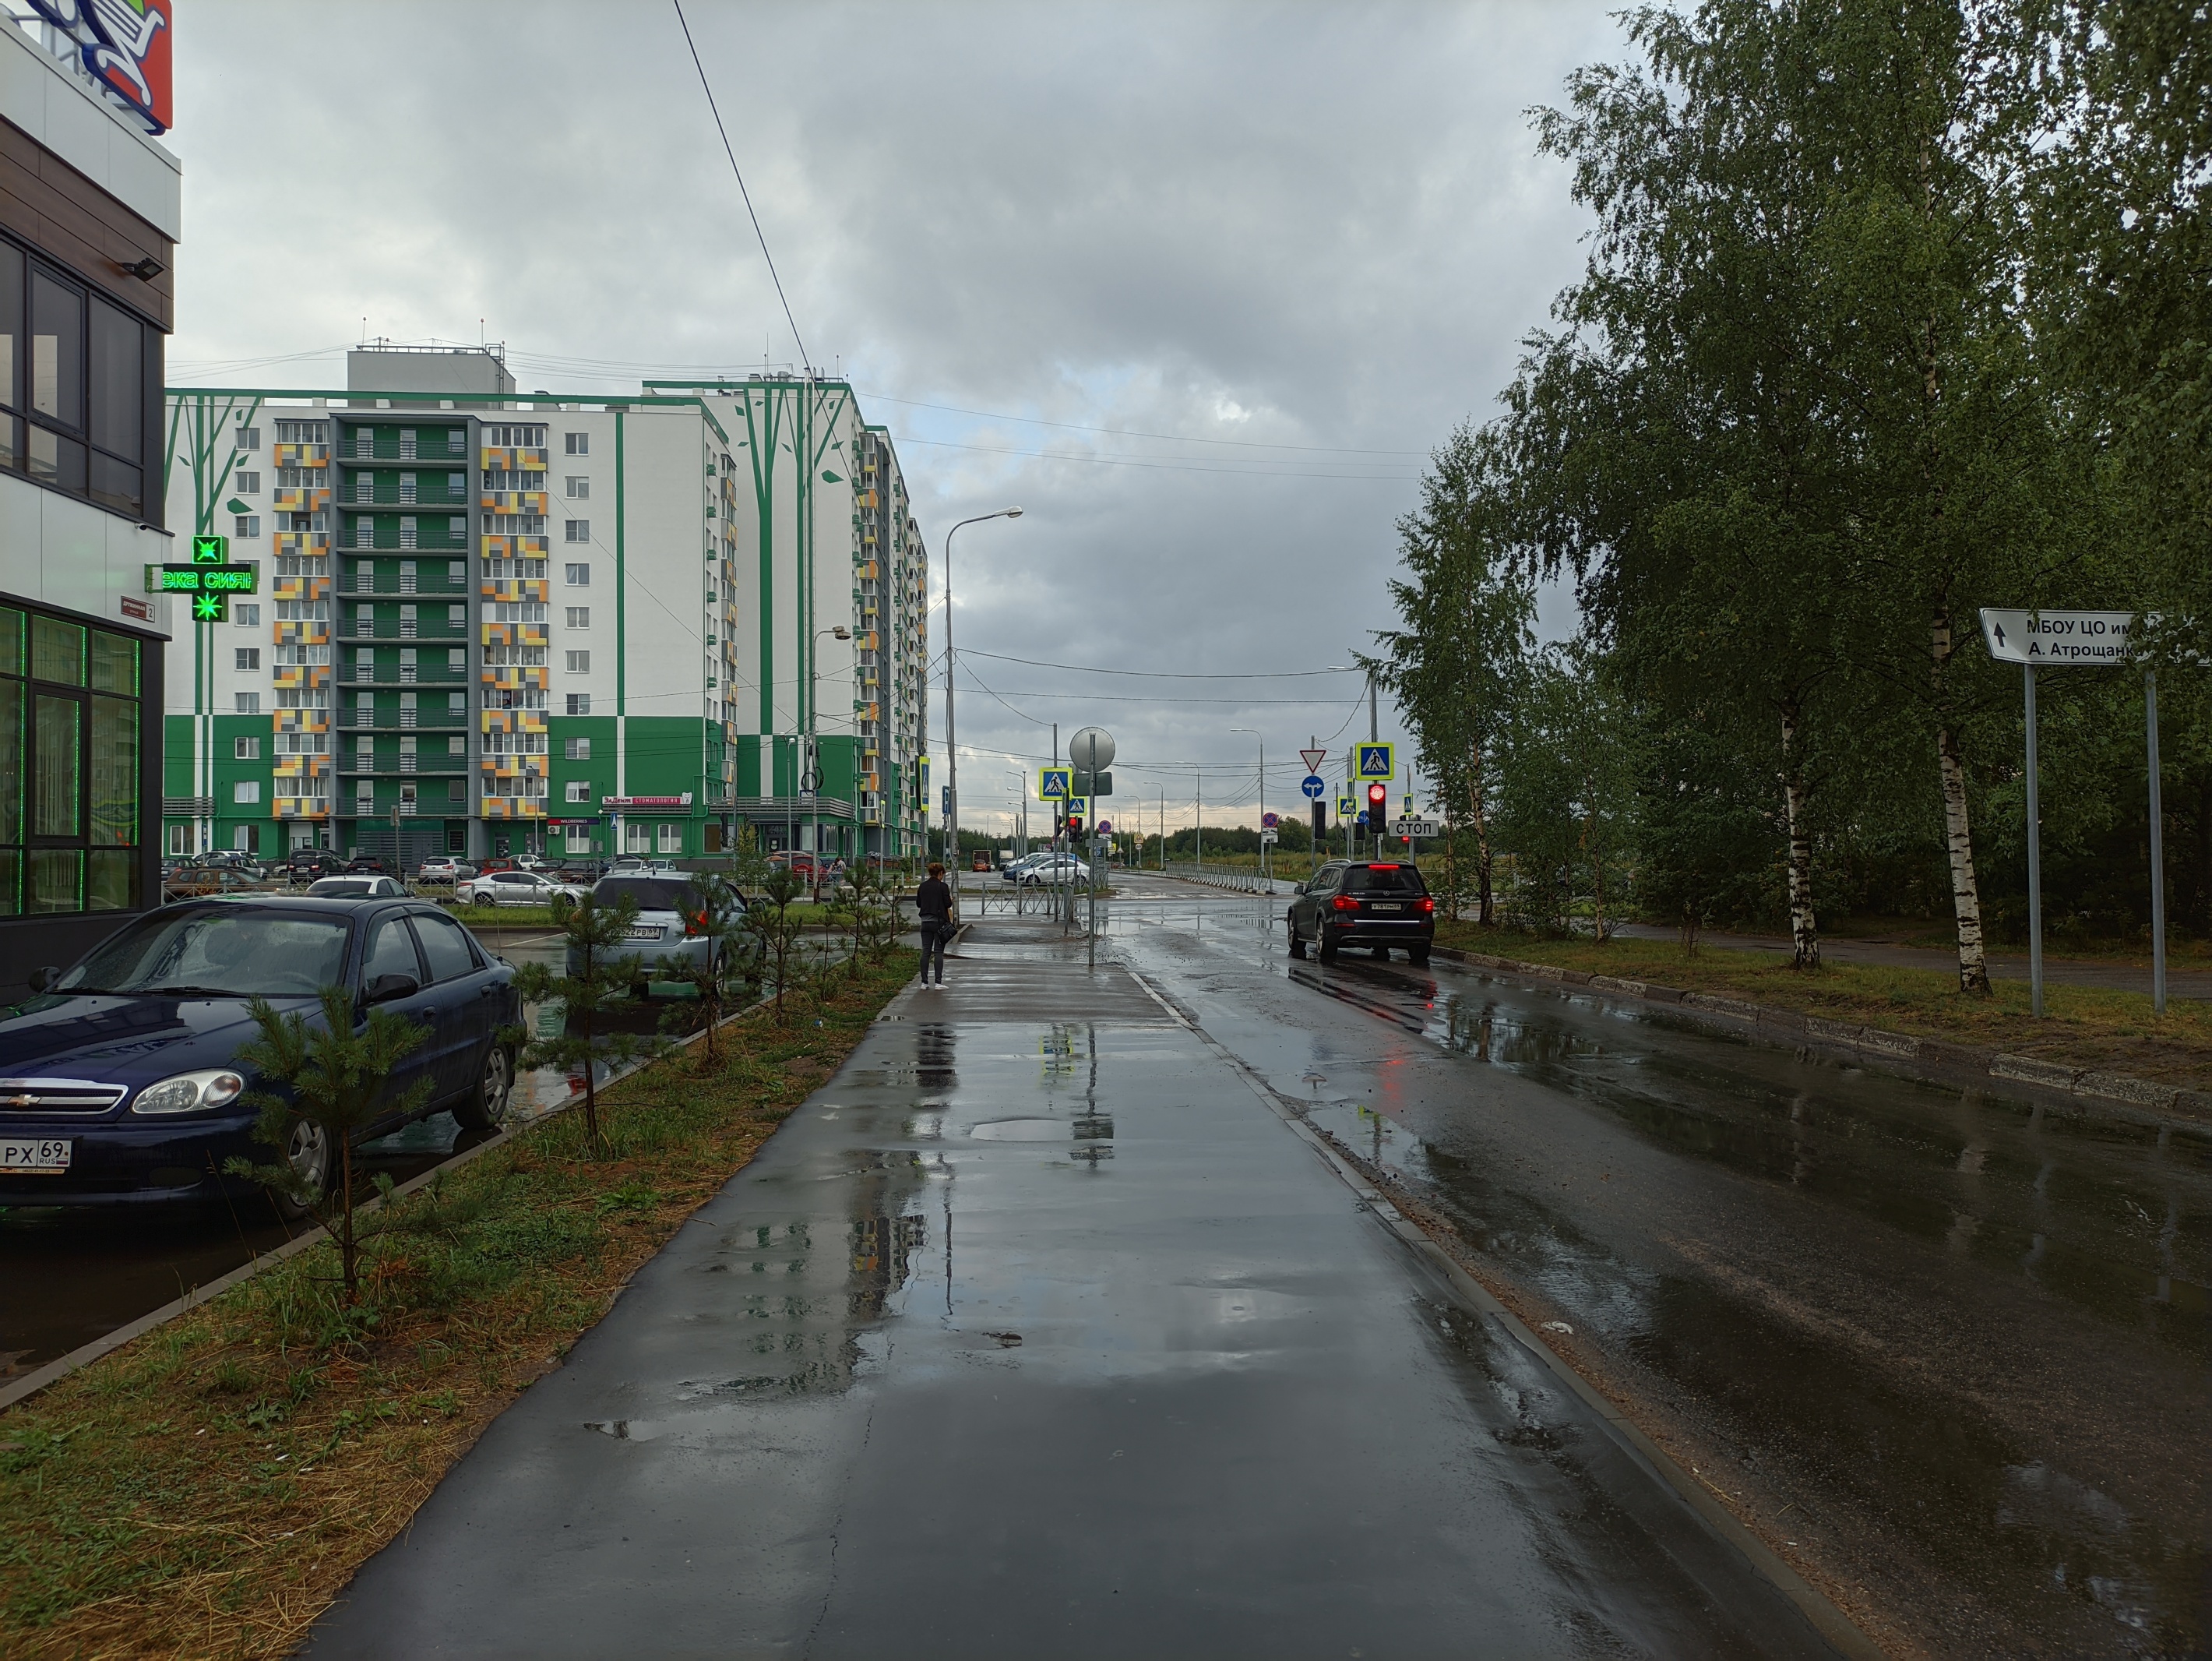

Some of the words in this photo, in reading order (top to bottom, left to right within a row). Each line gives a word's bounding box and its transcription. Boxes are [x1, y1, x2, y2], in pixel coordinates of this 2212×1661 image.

[148, 608, 153, 618] 2
[2027, 620, 2075, 634] МБОУ
[2080, 620, 2105, 637] ЦО
[2028, 642, 2045, 656] А.
[1397, 823, 1431, 834] СТОП
[41, 1142, 64, 1158] 69
